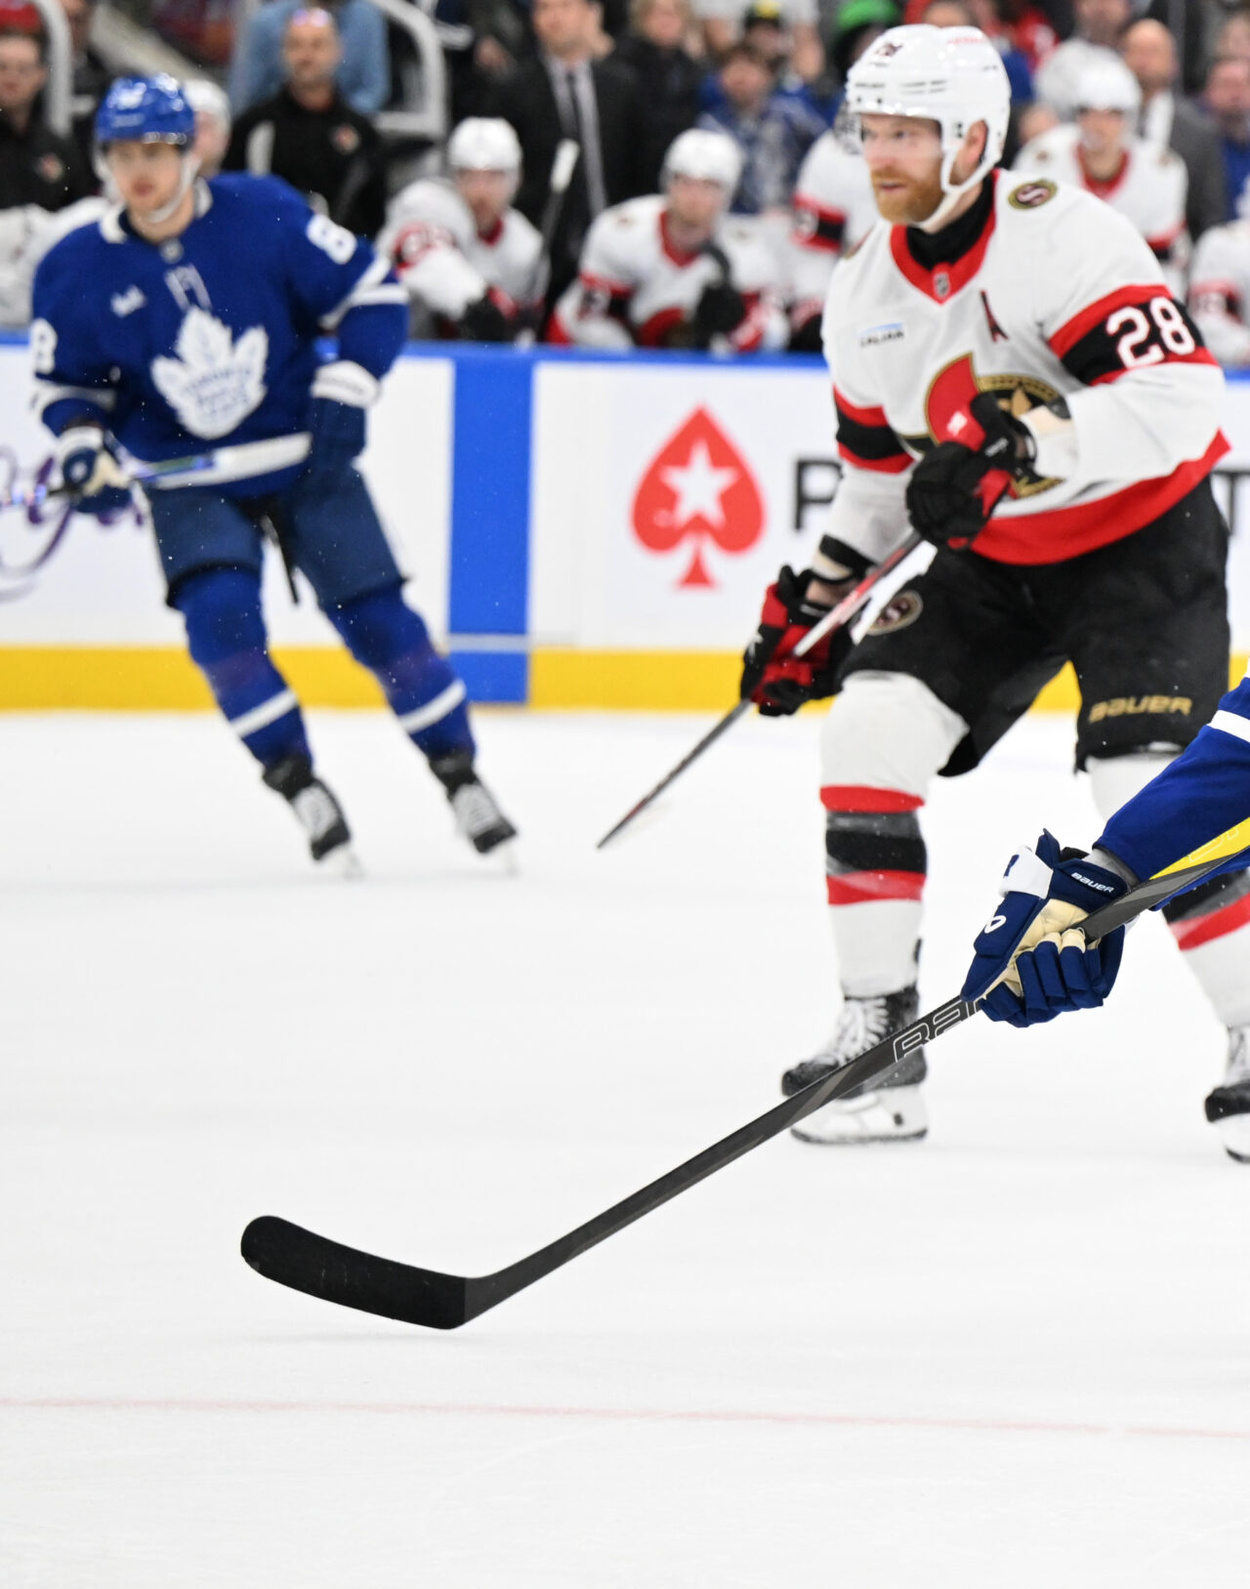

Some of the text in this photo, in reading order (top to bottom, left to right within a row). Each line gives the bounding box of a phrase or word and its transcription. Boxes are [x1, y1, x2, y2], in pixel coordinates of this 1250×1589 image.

[980, 289, 1009, 342] A
[1106, 296, 1195, 369] 28
[1071, 872, 1115, 893] BAUER
